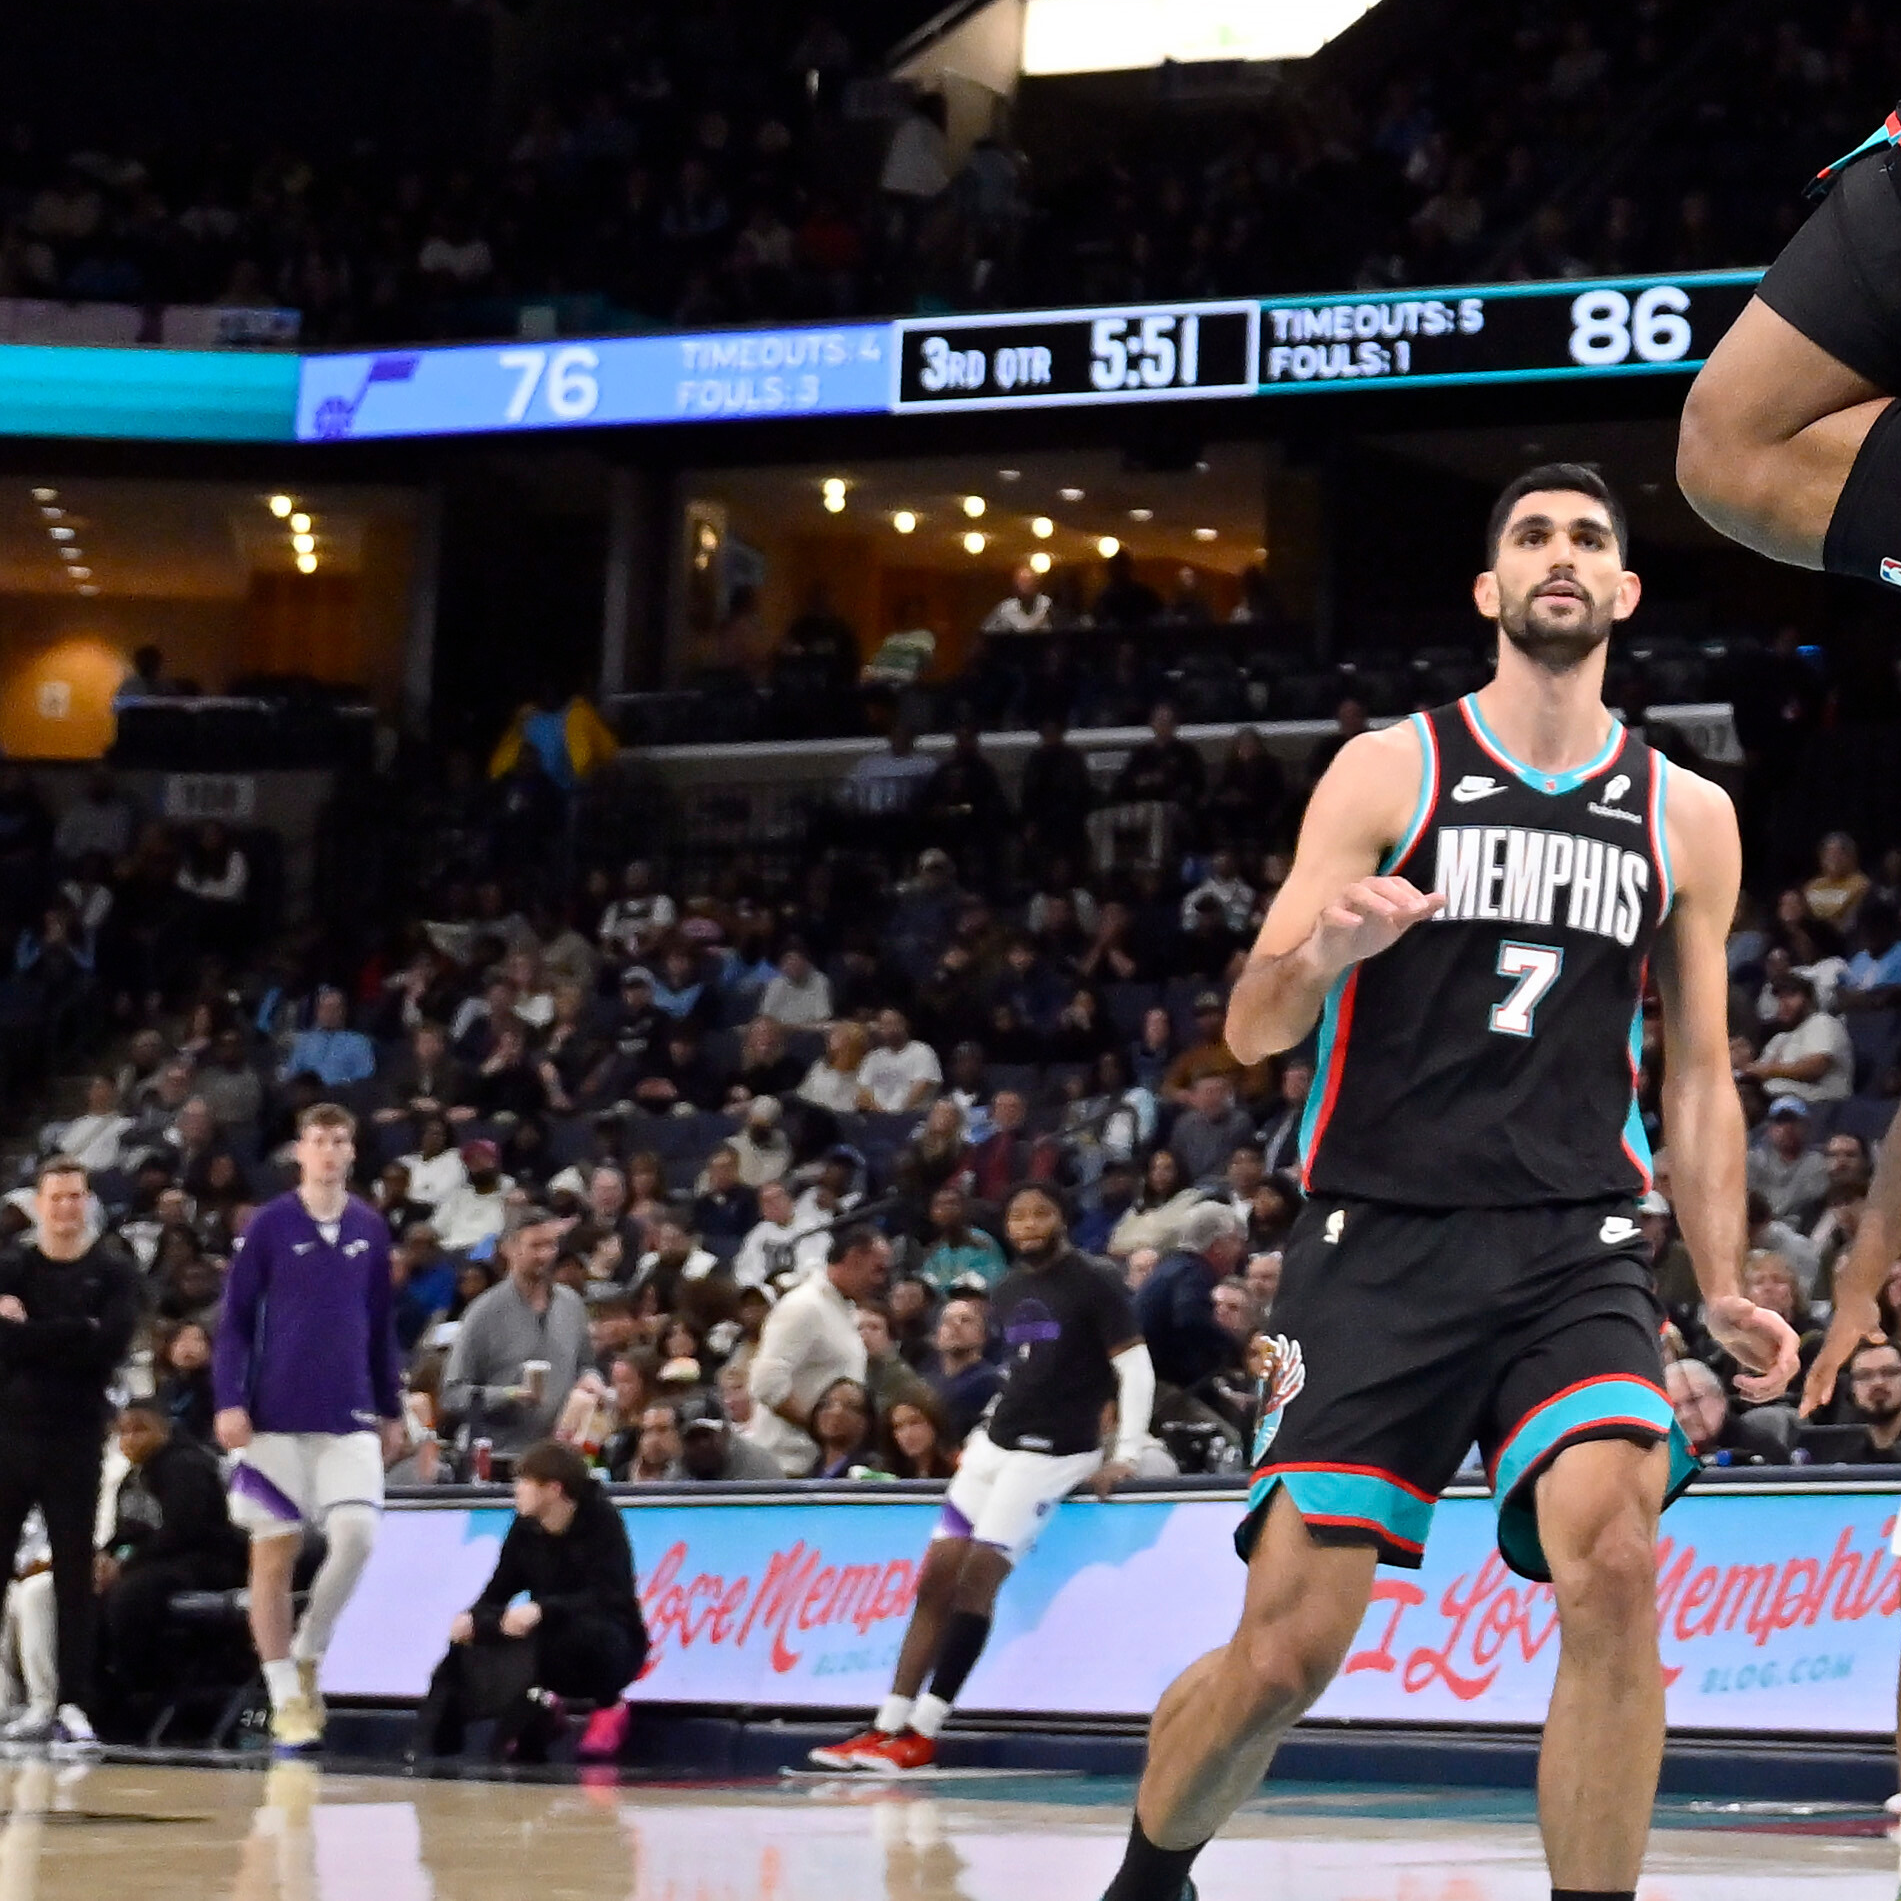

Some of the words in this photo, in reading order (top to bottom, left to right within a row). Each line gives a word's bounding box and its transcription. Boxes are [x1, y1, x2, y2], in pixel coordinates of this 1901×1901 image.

[681, 333, 857, 370] TIMEOUTS:
[921, 336, 985, 392] 3RD
[995, 347, 1053, 388] QTR
[1090, 315, 1198, 391] 5:51
[1570, 286, 1692, 367] 86
[500, 346, 599, 423] 76
[676, 377, 787, 414] FOULS:
[1432, 825, 1648, 947] MEMPHIS
[1489, 940, 1563, 1037] 7
